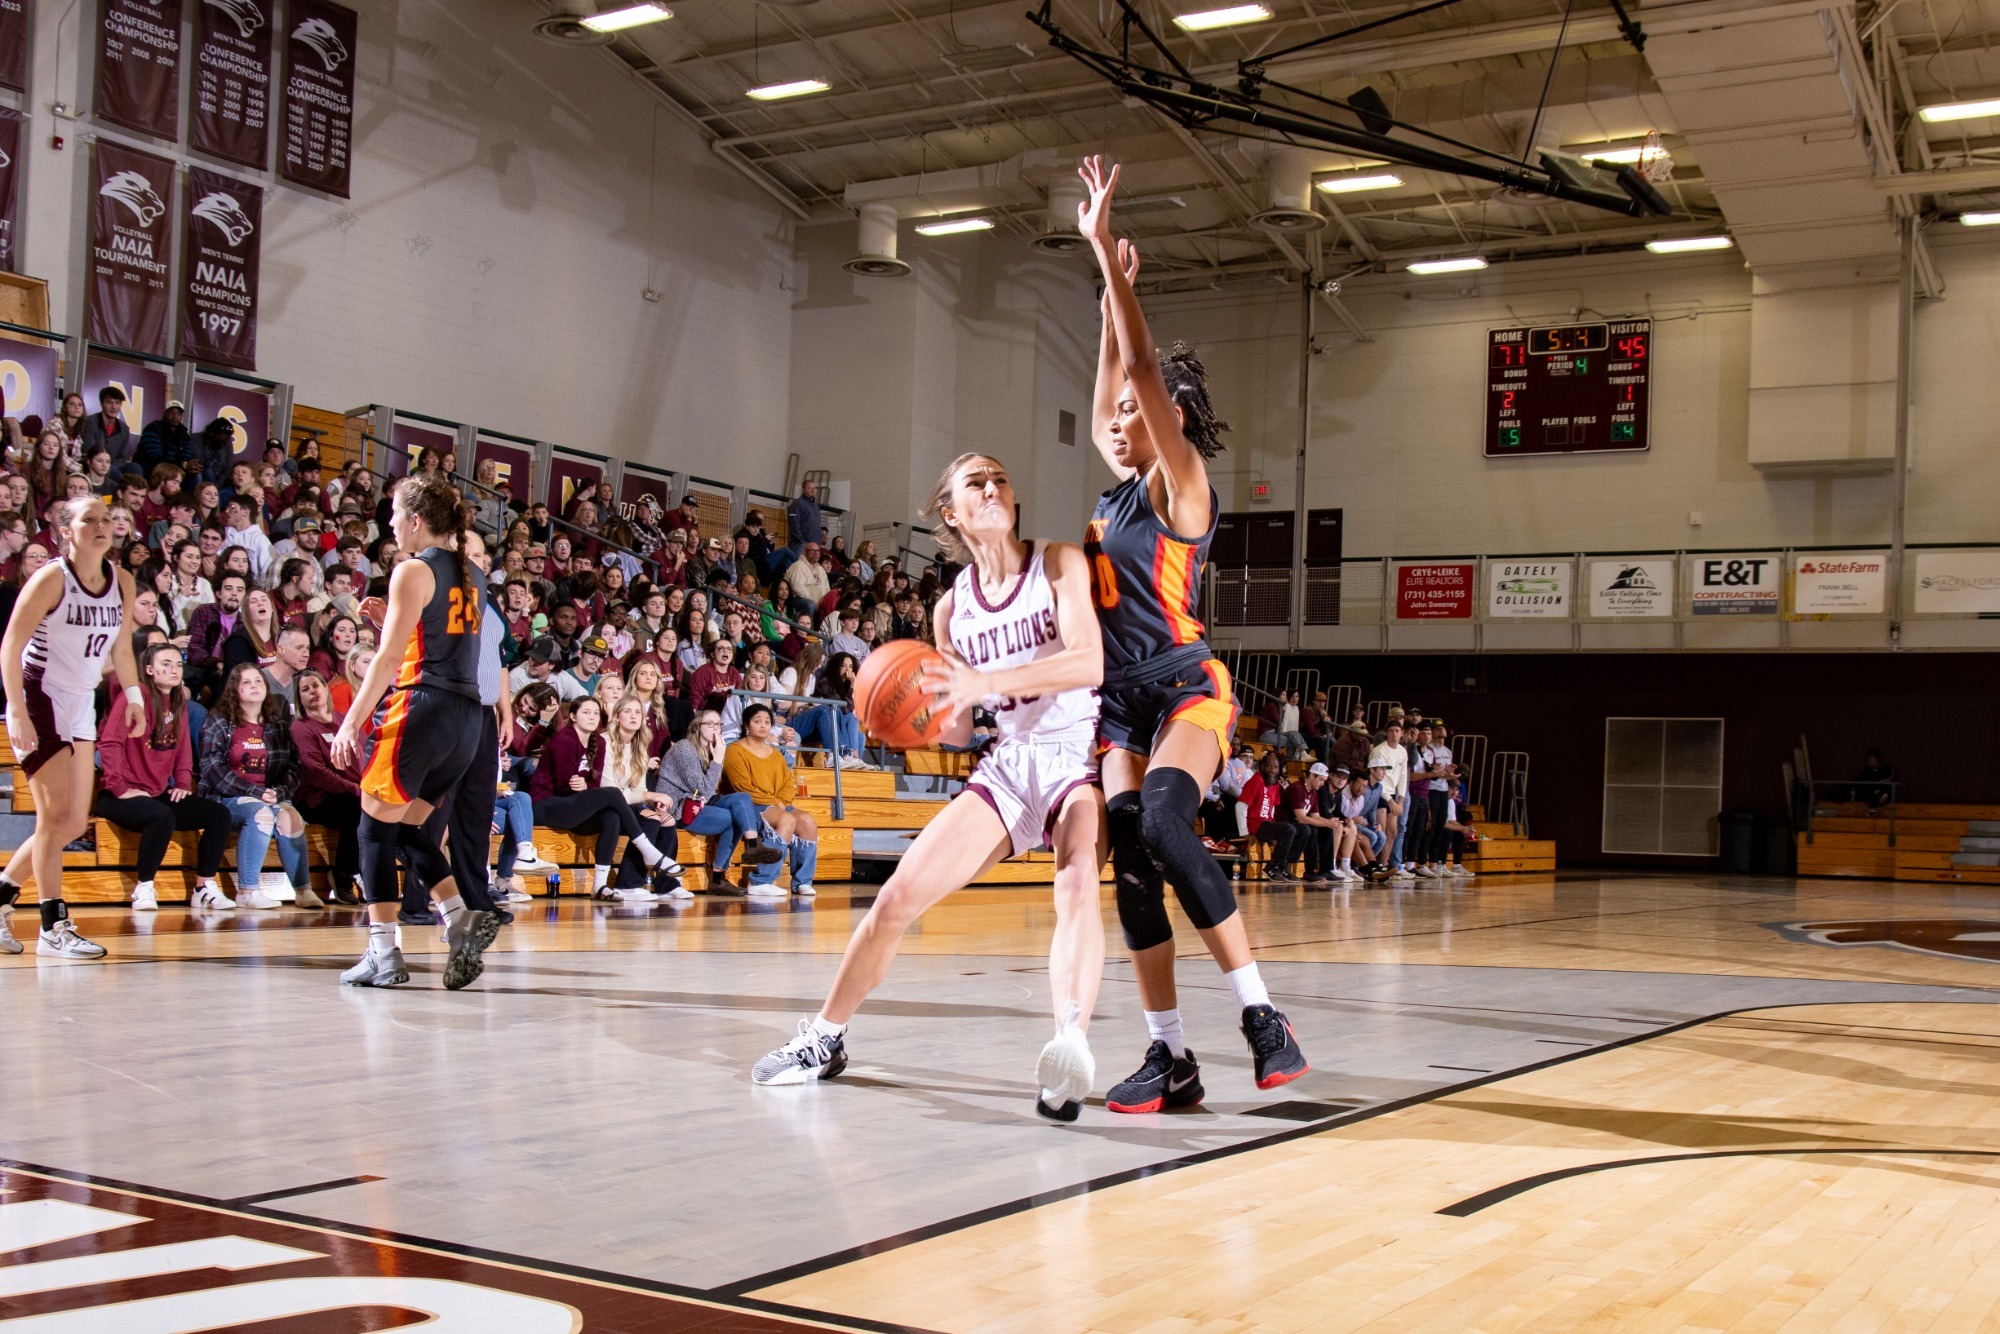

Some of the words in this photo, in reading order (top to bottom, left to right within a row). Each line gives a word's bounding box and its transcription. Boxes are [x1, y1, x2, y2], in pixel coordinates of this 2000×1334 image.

[123, 0, 162, 19] VOLLEYBALL
[110, 10, 175, 39] CONFERENCE
[105, 19, 178, 51] CHAMPIONSHIP
[213, 31, 234, 44] MEN'S
[235, 38, 256, 52] TENNIS
[205, 42, 262, 72] CONFERENCE
[200, 52, 267, 83] CHAMPIONSHIP
[294, 64, 324, 79] WOMEN'S
[291, 77, 348, 104] CONFERENCE
[287, 86, 351, 114] CHAMPIONSHIP
[113, 224, 153, 241] VOLLEYBALL
[112, 234, 153, 258] NAIA
[94, 247, 167, 274] TOURNAMENT
[201, 247, 221, 258] MEN'S
[222, 252, 244, 264] TENNIS
[96, 266, 114, 276] 2009
[123, 272, 140, 282] 2010
[195, 261, 247, 293] NAIA
[190, 282, 251, 307] CHAMPIONS
[217, 304, 244, 316] DOUBLES
[198, 311, 240, 336] 1997
[1611, 323, 1649, 334] VISITOR
[1495, 332, 1522, 342] HOME
[1500, 346, 1524, 365] 71
[1619, 337, 1645, 358] 45
[1504, 369, 1528, 378] BONUS
[1547, 361, 1574, 370] PERIOD
[1576, 358, 1587, 372] 4
[1608, 363, 1632, 371] BONUS
[1492, 383, 1526, 391] TIMEOUTS
[1609, 376, 1645, 384] TIMEOUTS
[1504, 392, 1514, 408] 2
[1499, 420, 1520, 428] FOULS
[1542, 418, 1568, 426] PLAYER
[1574, 416, 1596, 424] FOULS
[1612, 414, 1635, 422] FOULS
[1510, 430, 1518, 445] 5
[1623, 425, 1633, 436] 4
[1504, 566, 1556, 575] GATELY
[1704, 560, 1768, 586] E&T
[1405, 591, 1425, 600] (731)
[1427, 590, 1465, 598] 435-1155
[1496, 596, 1562, 604] COLLISION
[66, 603, 97, 626] LADY
[1003, 608, 1057, 655] LIONS
[84, 633, 108, 658] 10
